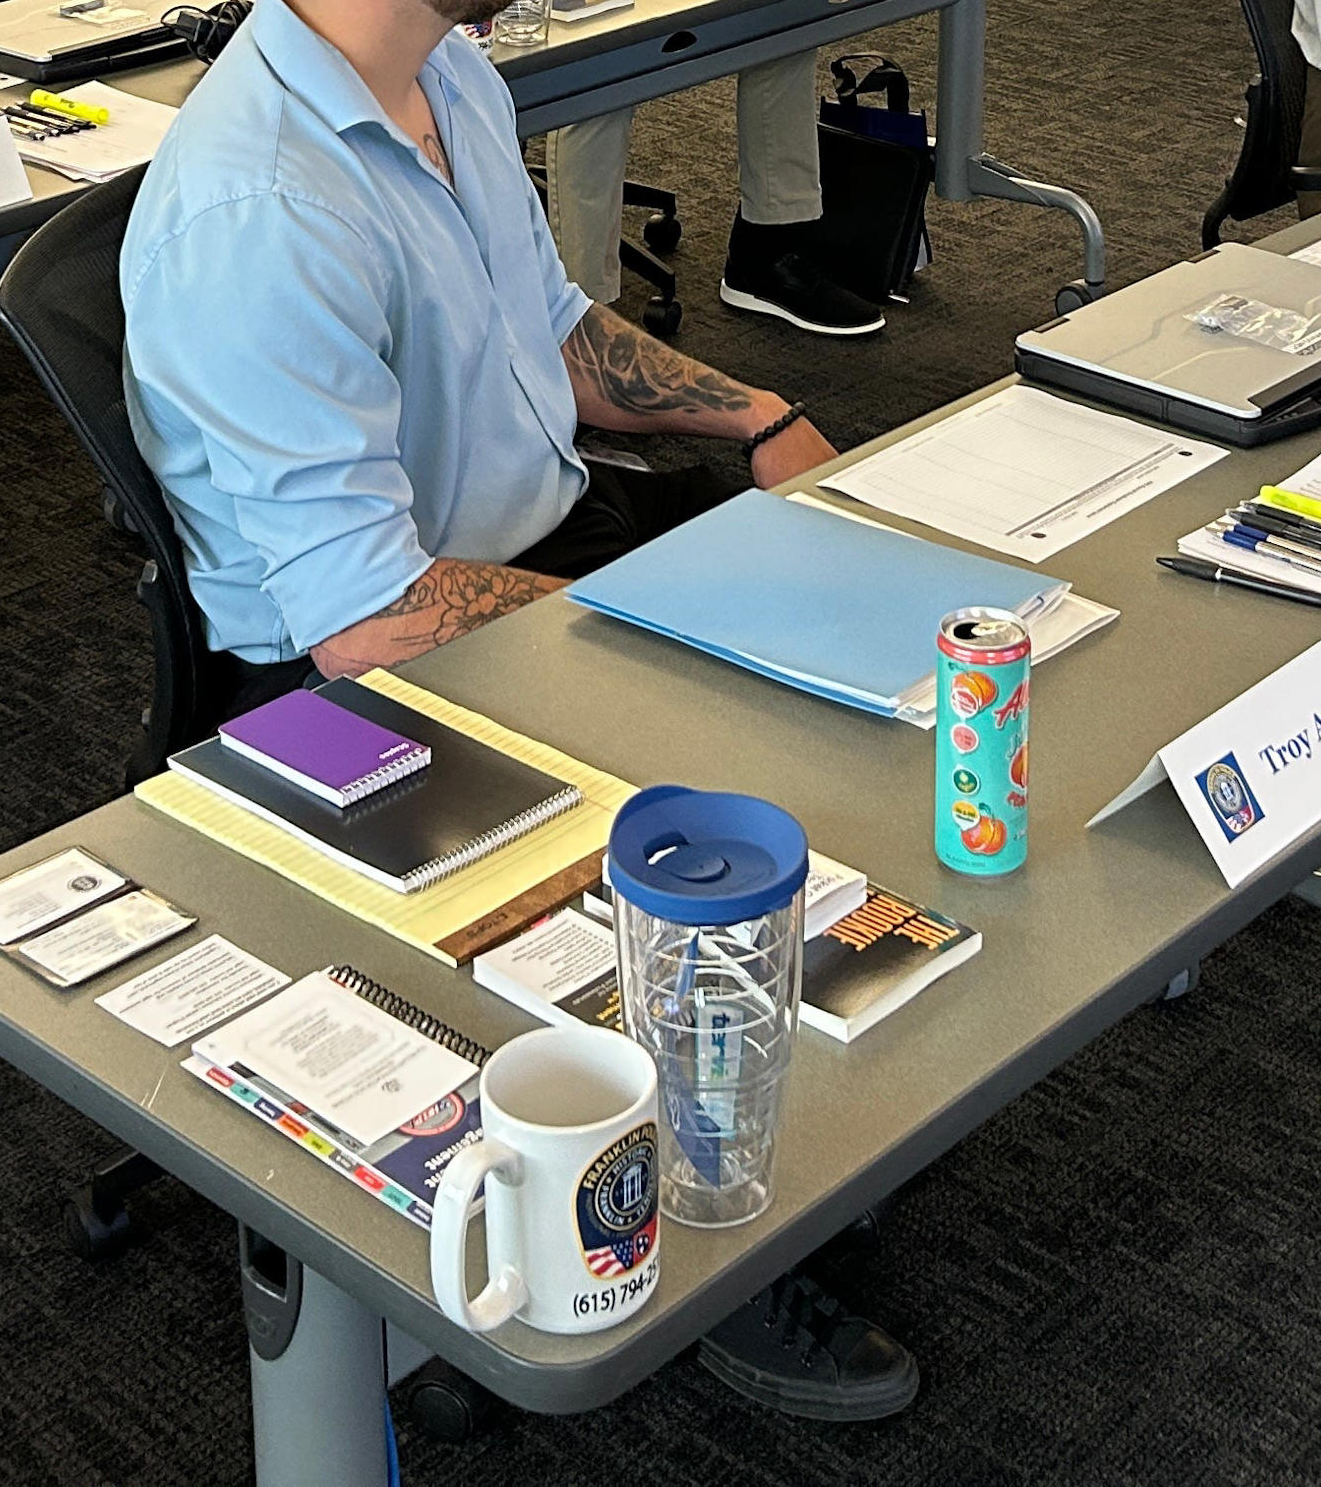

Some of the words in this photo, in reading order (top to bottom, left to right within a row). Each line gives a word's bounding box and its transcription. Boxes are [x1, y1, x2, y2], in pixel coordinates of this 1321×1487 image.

[1258, 728, 1313, 775] Troy
[892, 914, 961, 951] THE
[582, 1130, 642, 1190] FRANKLIN
[573, 1287, 616, 1318] (615)
[620, 1258, 659, 1305] 794-25
